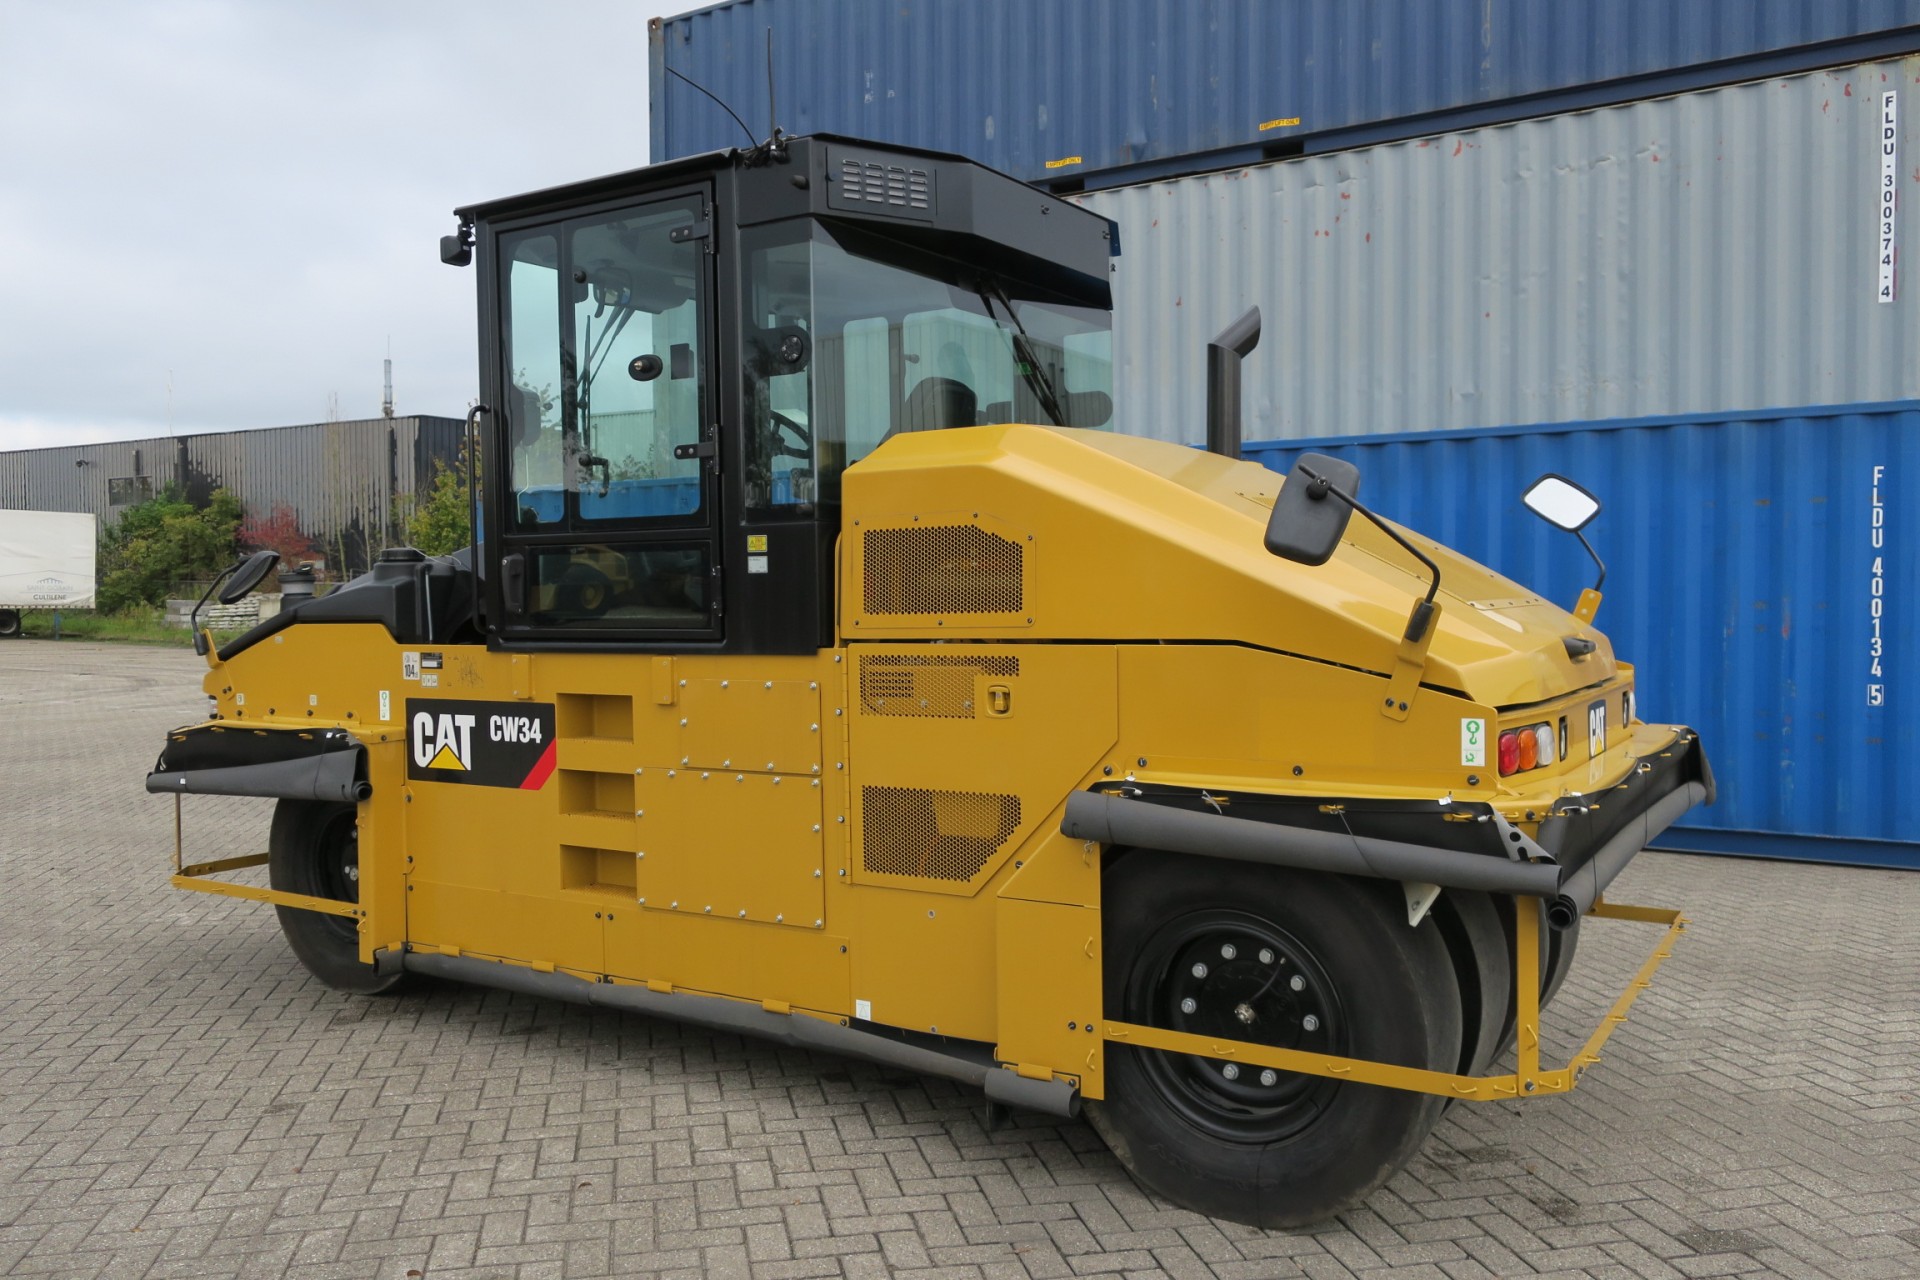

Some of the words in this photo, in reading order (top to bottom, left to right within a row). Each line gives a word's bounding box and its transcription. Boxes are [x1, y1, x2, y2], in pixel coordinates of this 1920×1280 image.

[1872, 466, 1885, 548] FLDU
[1870, 557, 1884, 677] 400134
[405, 664, 415, 677] 104
[1870, 685, 1882, 706] 5
[413, 711, 476, 771] CAT
[489, 714, 542, 744] CW34
[1589, 706, 1605, 757] CAT
